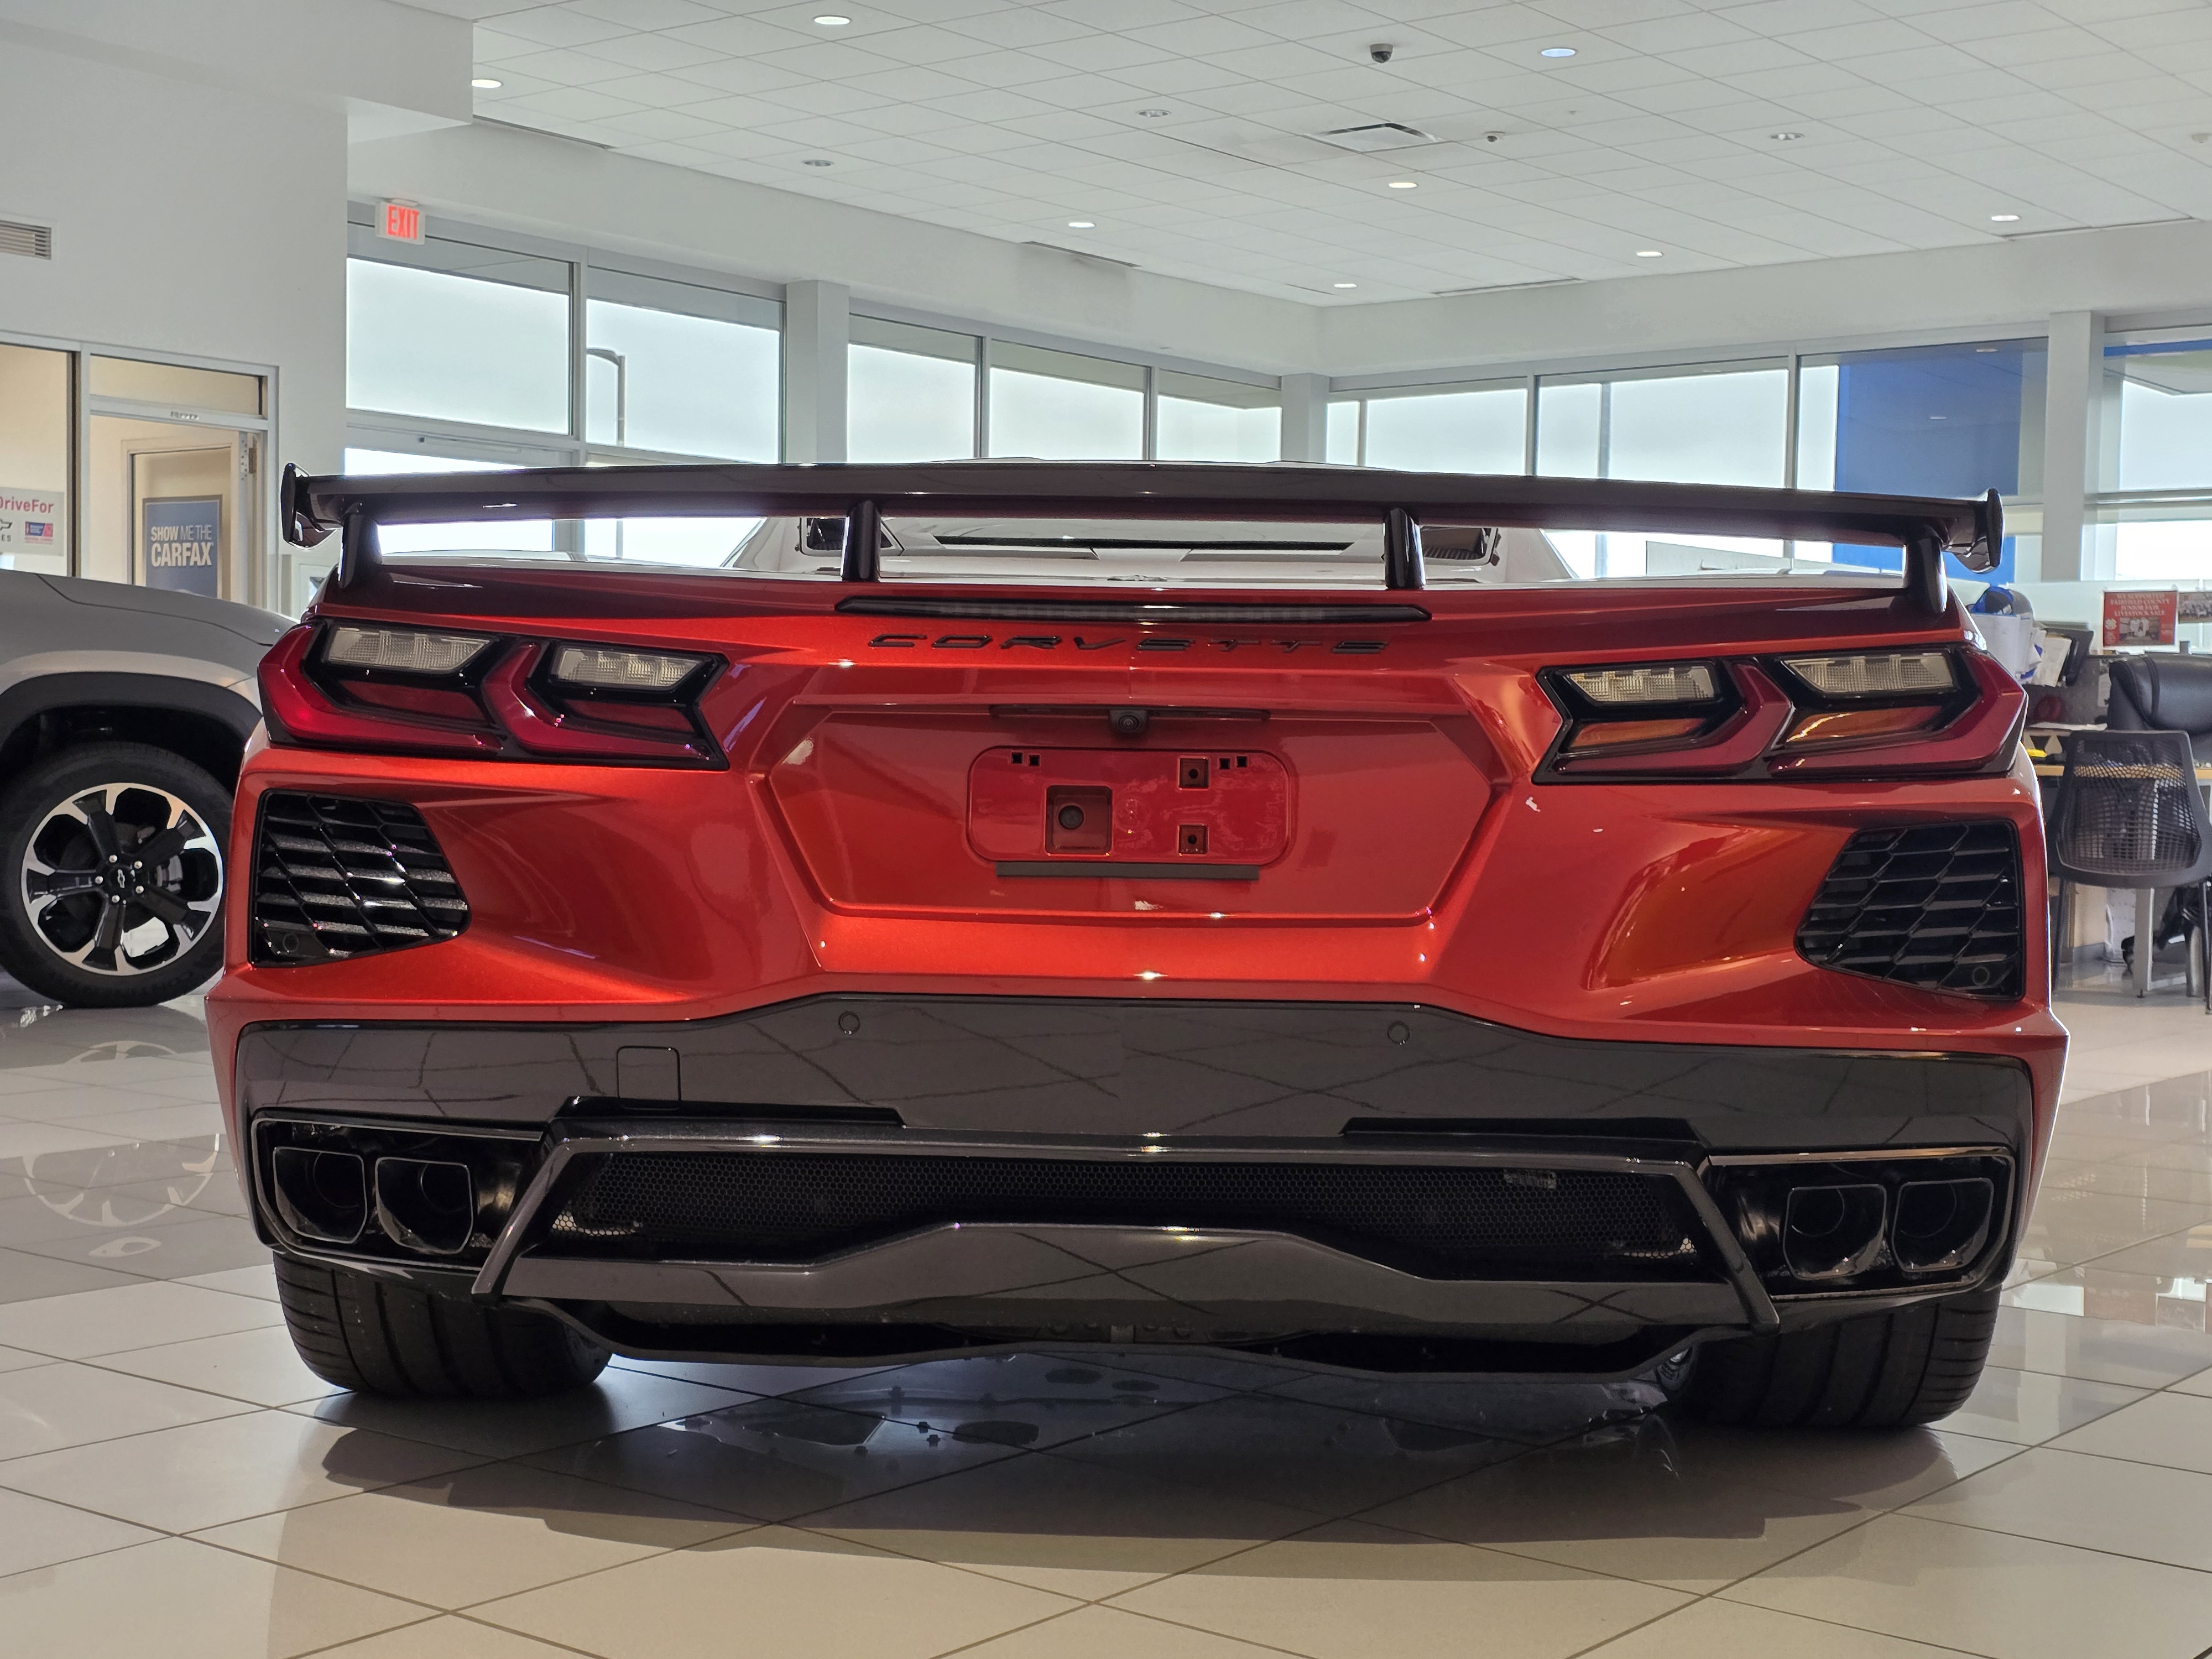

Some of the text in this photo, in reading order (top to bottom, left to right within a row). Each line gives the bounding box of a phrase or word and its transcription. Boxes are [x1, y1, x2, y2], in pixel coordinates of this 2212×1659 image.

[387, 205, 420, 240] EXIT
[151, 524, 212, 541] SHOW ME THE
[151, 542, 212, 567] CARFAX
[868, 633, 1389, 654] CORVETTE
